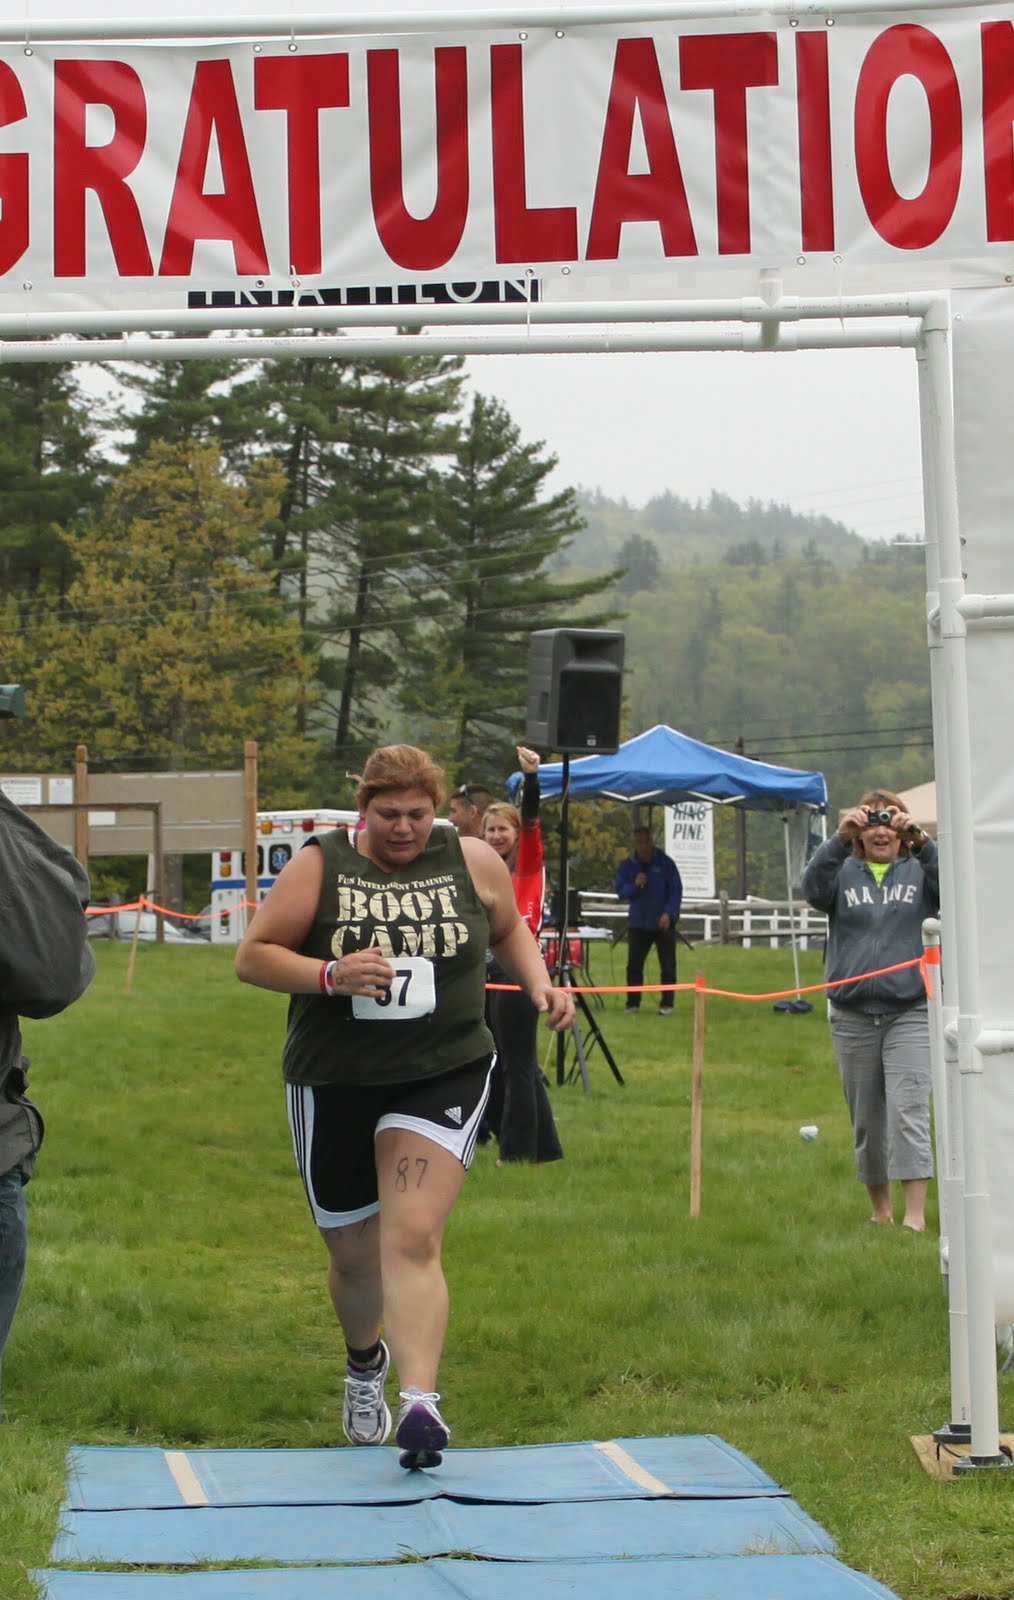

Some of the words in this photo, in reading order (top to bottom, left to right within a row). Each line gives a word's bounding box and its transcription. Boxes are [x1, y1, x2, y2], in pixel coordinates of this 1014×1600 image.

[673, 823, 705, 840] PINE
[411, 874, 453, 889] TRAINING
[844, 884, 917, 907] MAINE
[337, 885, 458, 922] BOOT
[331, 922, 469, 960] CAMP
[396, 1157, 428, 1193] 87
